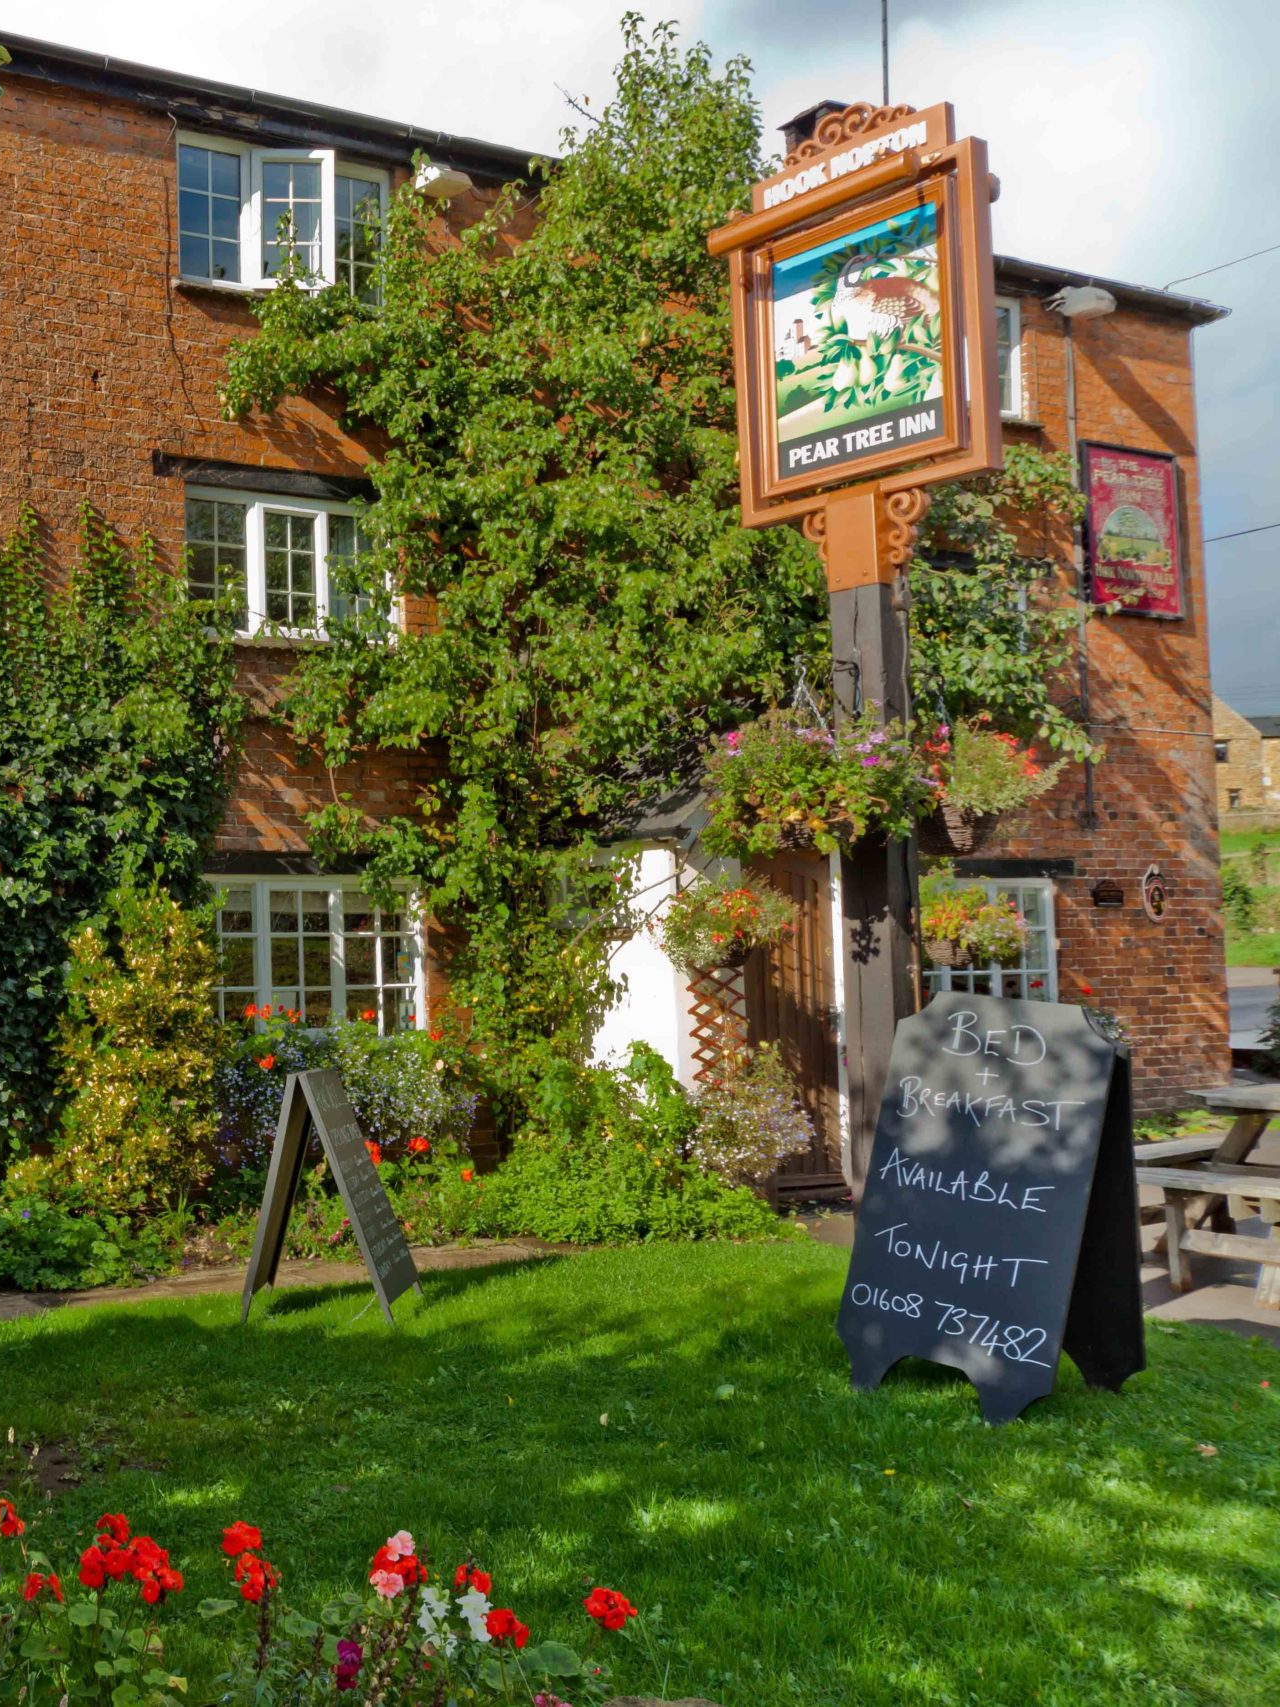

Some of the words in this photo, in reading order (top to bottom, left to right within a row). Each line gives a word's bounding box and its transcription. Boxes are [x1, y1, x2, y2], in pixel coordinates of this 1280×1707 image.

[763, 161, 829, 210] HOOK
[788, 437, 840, 469] PEAR
[842, 421, 894, 453] TREE
[899, 409, 936, 439] INN
[1093, 469, 1128, 485] PEAR
[942, 1010, 1047, 1066] BED
[896, 1075, 1086, 1131] BREAKFAST
[975, 1067, 999, 1086] +
[879, 1147, 1056, 1213] AVAILABLE
[874, 1222, 1049, 1288] TONIGHT
[851, 1283, 923, 1318] 01608
[934, 1301, 1052, 1369] 737482
